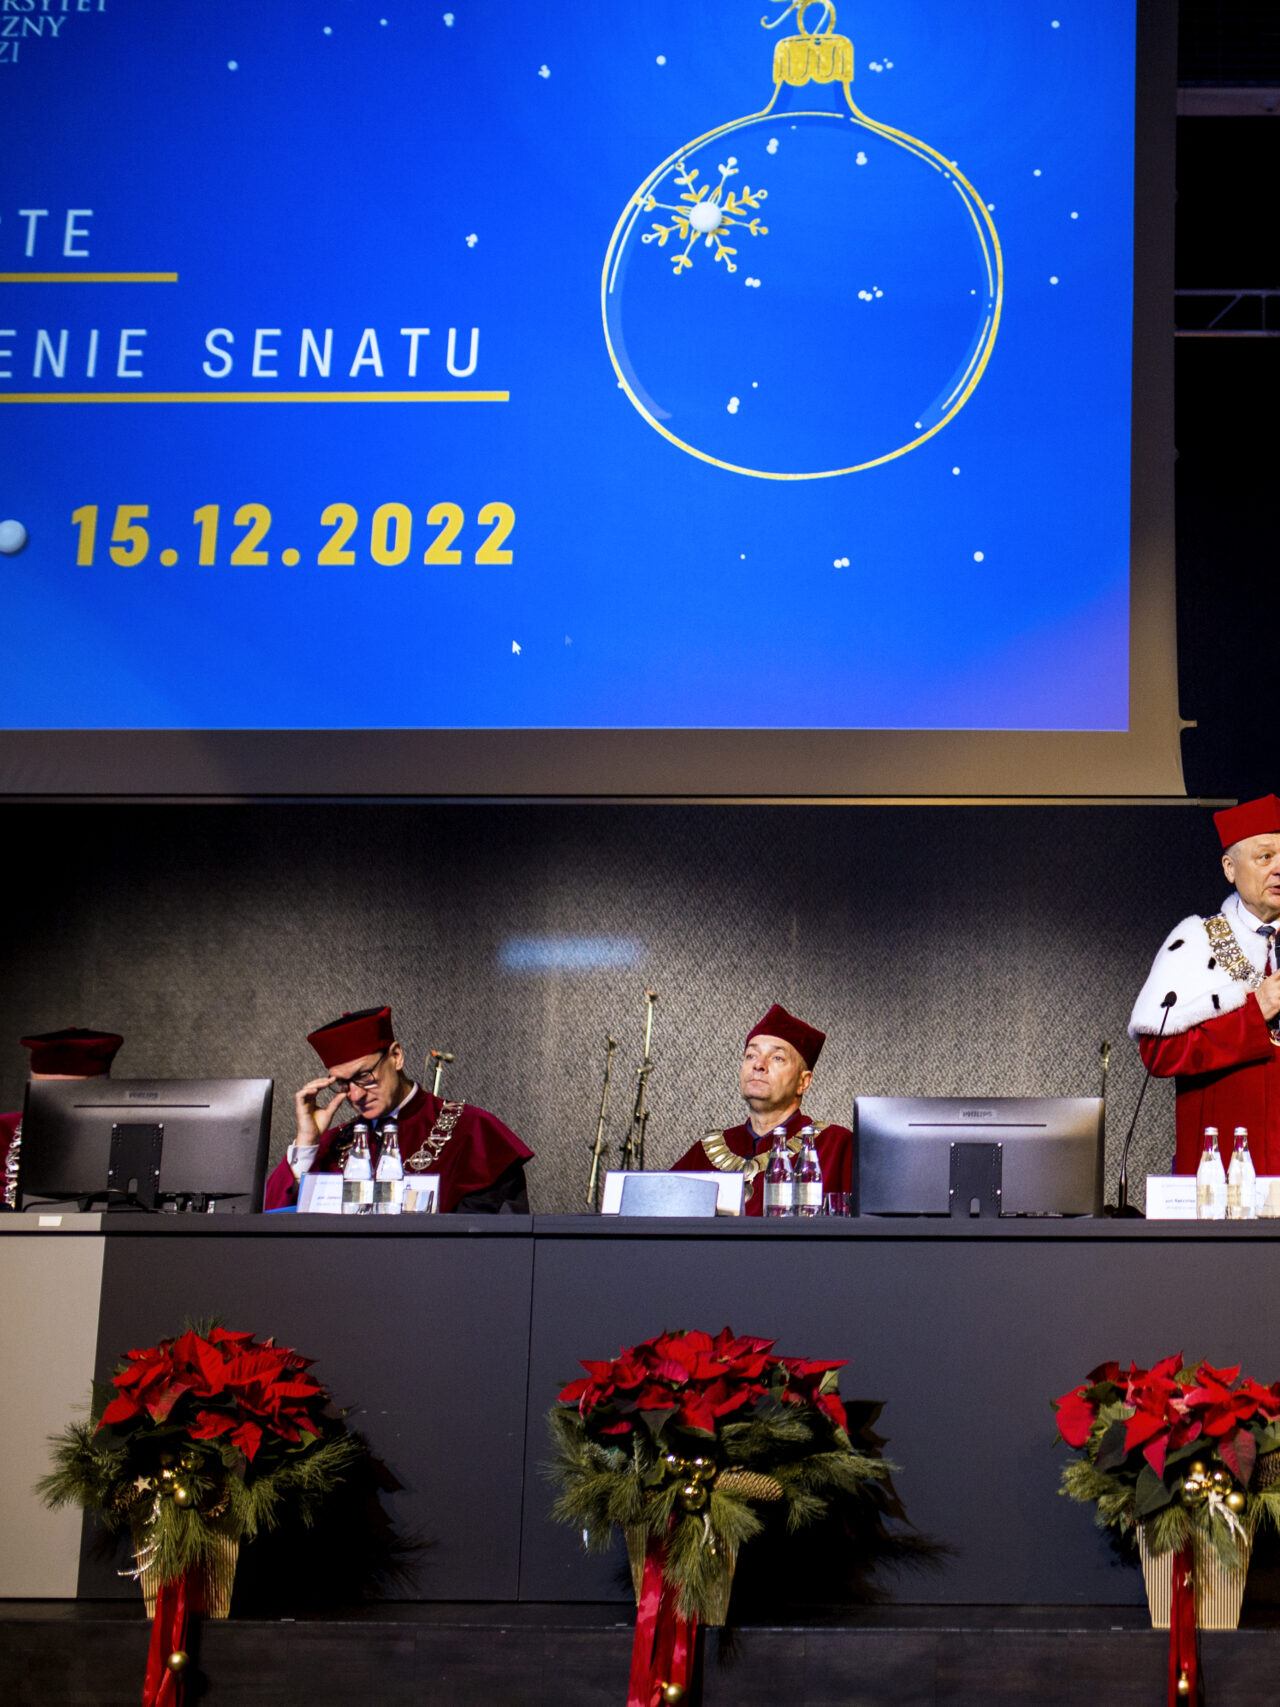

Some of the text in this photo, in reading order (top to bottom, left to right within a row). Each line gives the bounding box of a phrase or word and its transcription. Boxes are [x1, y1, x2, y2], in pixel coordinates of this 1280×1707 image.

[1, 16, 66, 37] ZNY
[0, 208, 93, 257] TE
[202, 327, 480, 378] SENATU
[71, 501, 516, 567] 15.12.2022
